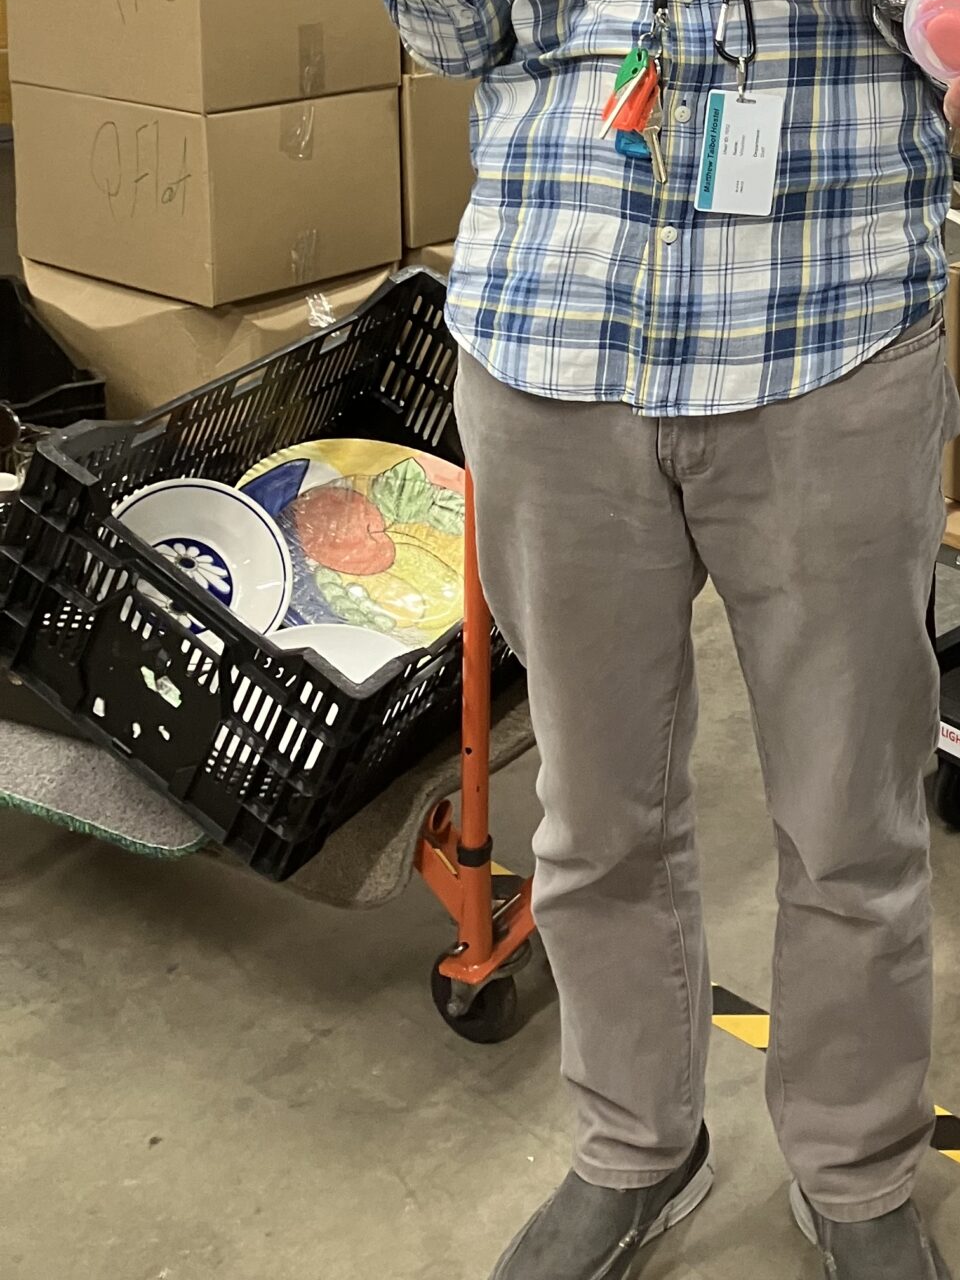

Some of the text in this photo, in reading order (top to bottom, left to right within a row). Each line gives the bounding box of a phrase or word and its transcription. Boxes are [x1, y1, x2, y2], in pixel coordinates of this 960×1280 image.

[703, 108, 720, 193] Matthew Talbot Hostel
